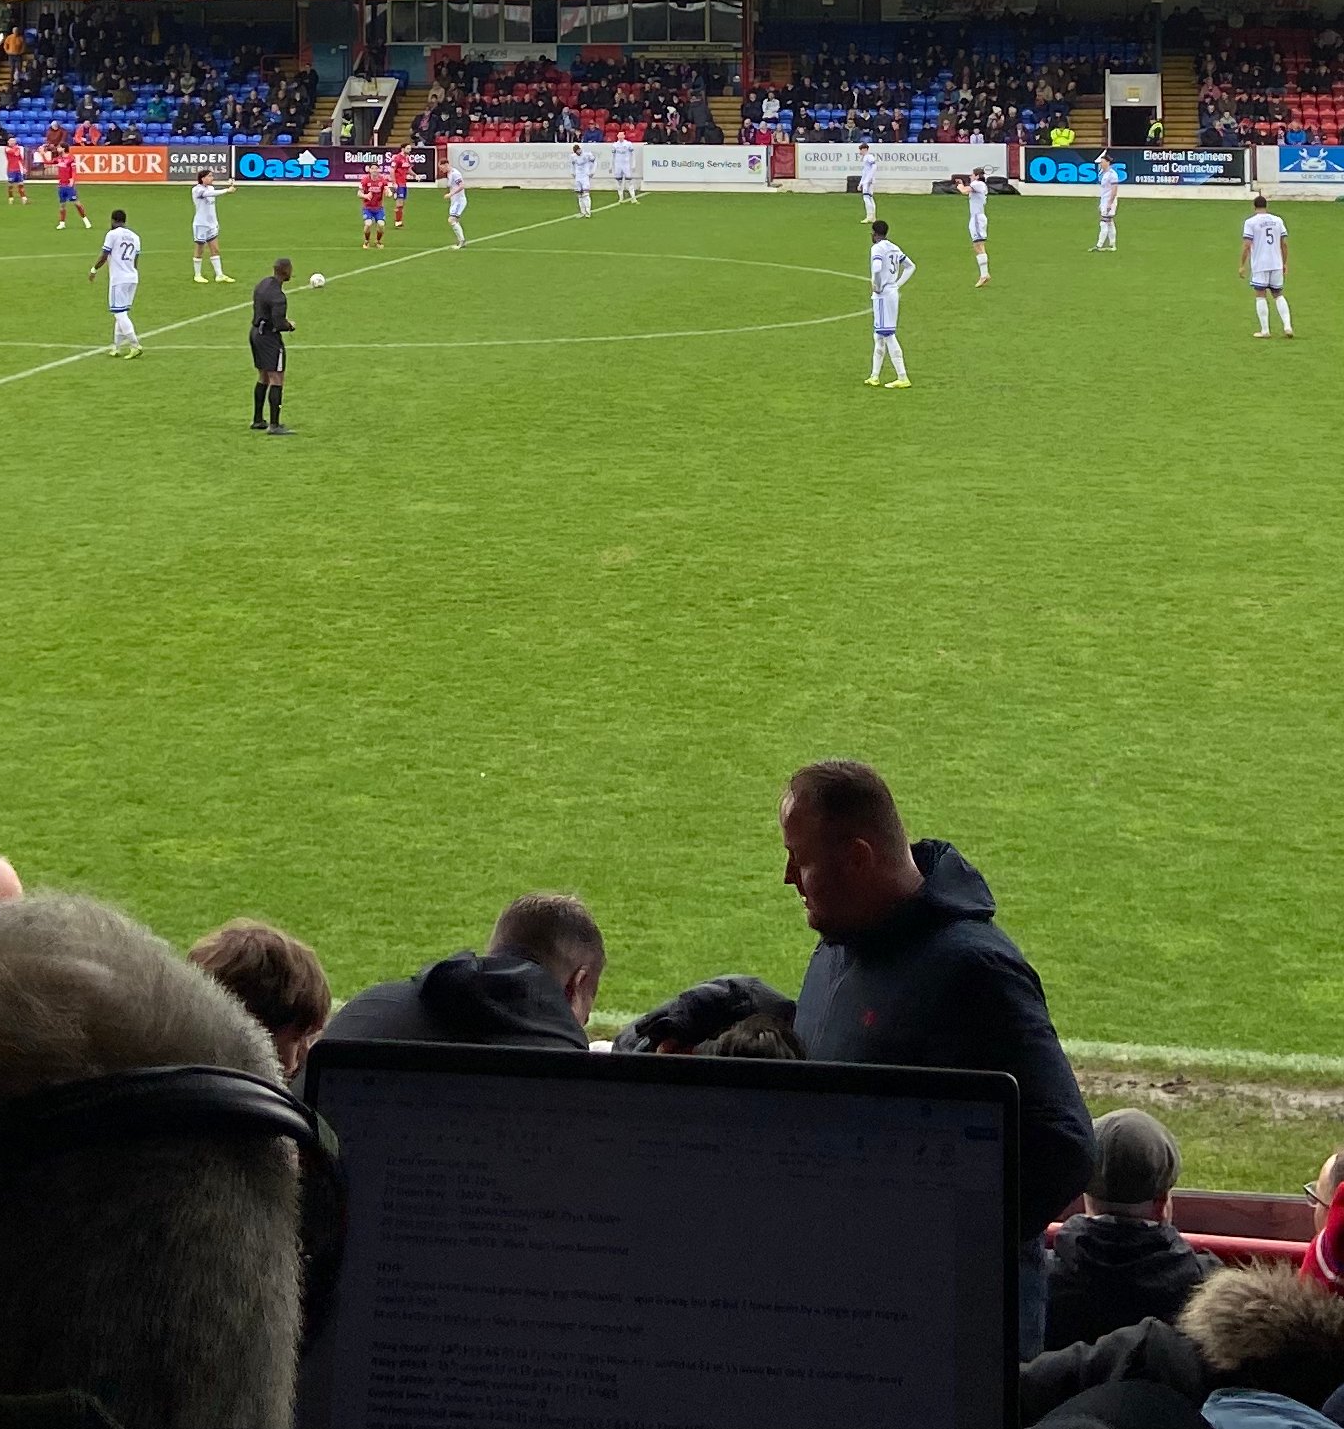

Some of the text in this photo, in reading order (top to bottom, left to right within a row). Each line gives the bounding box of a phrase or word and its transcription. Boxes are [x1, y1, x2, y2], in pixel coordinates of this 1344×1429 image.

[170, 153, 227, 164] GARDEN
[344, 151, 383, 165] Building
[804, 152, 843, 162] GROUP
[846, 152, 851, 162] 1
[1143, 150, 1233, 163] Electrical Engineers
[75, 153, 164, 175] KEBUR
[239, 150, 331, 179] Oasis
[651, 158, 742, 170] RLD Building Services
[1029, 156, 1128, 183] Oass
[1152, 162, 1224, 174] and Contractors
[1265, 227, 1274, 245] 5
[119, 242, 135, 261] 22
